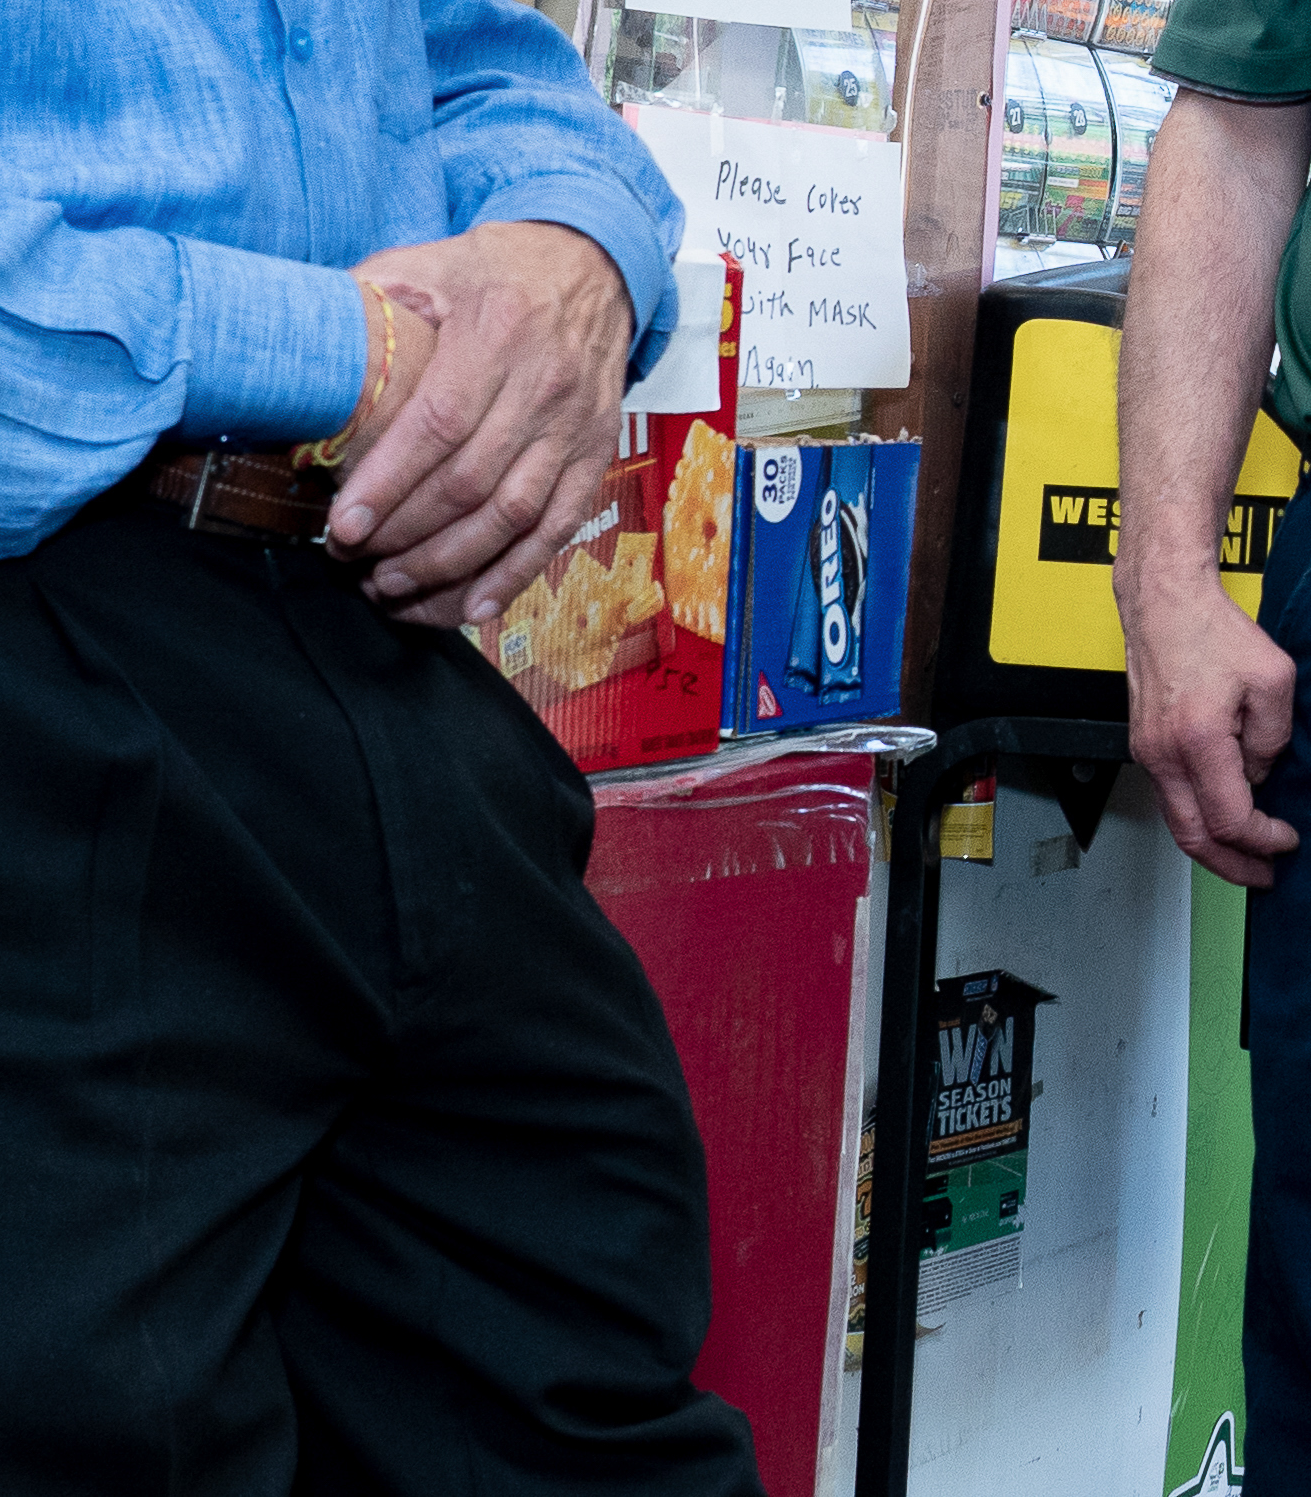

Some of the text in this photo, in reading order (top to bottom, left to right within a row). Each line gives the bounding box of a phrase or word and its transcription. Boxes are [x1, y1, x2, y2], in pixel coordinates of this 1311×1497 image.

[843, 78, 858, 97] 25
[1010, 108, 1021, 125] 27
[1073, 110, 1085, 127] 28
[715, 159, 787, 205] Please
[809, 298, 877, 330] MASK
[763, 458, 779, 502] 30
[779, 455, 788, 504] PACKS
[821, 488, 848, 665] OREO
[938, 1078, 1012, 1109] SEASON
[937, 1096, 1013, 1135] TICKETS
